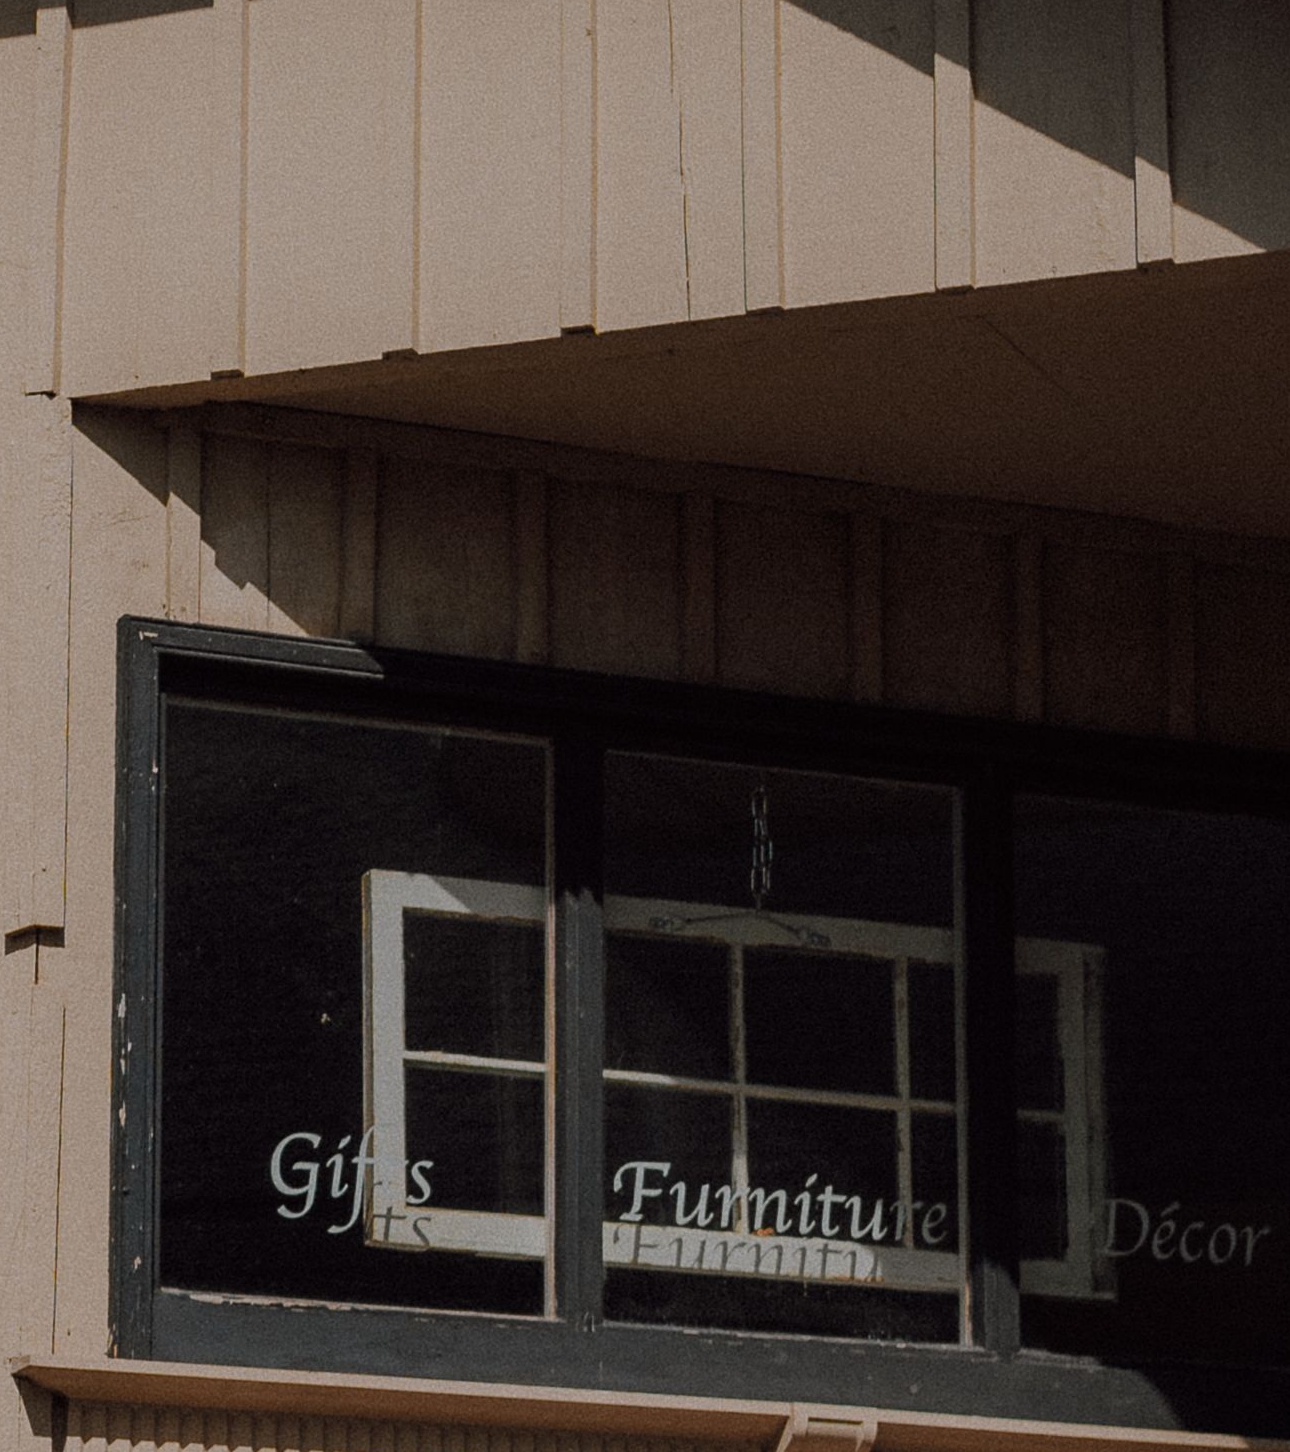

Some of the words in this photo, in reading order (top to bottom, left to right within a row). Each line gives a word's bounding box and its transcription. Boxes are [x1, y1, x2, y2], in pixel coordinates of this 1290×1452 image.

[270, 1125, 435, 1235] Gifs
[613, 1160, 949, 1245] Furniture
[1096, 1198, 1271, 1267] Décor
